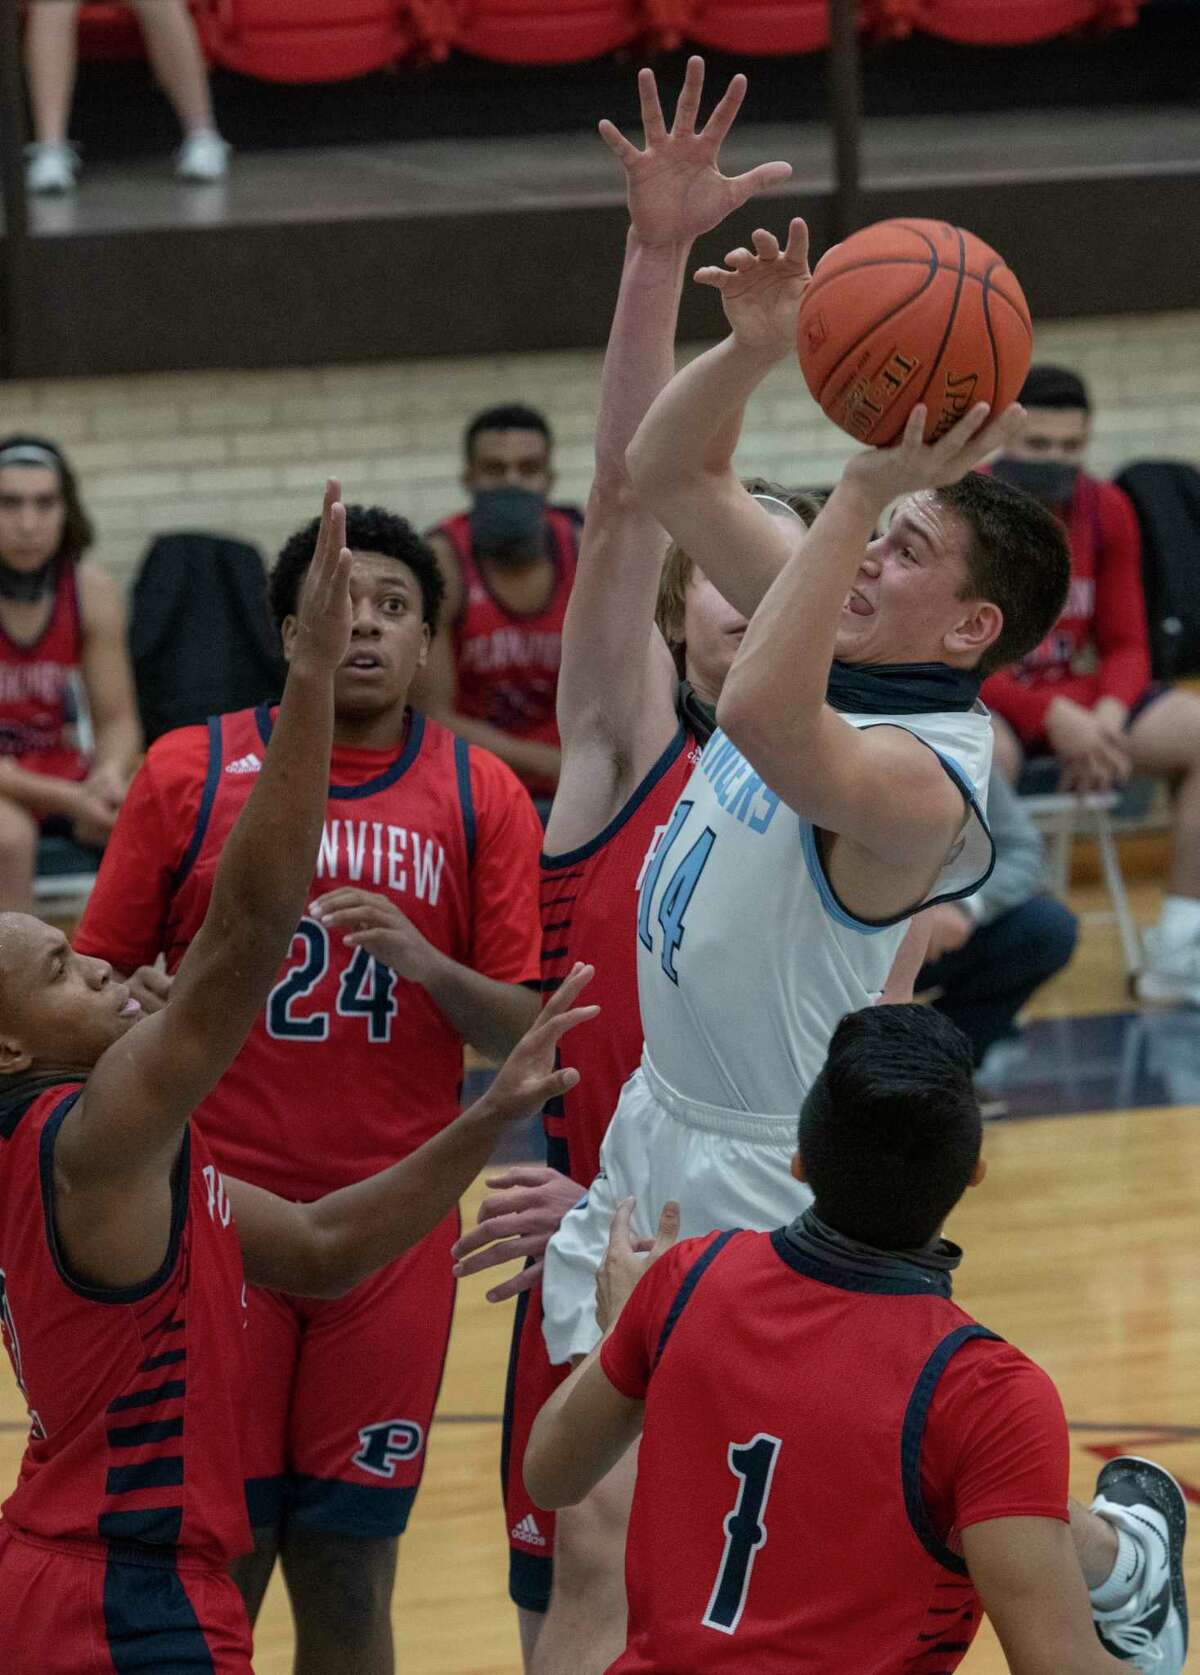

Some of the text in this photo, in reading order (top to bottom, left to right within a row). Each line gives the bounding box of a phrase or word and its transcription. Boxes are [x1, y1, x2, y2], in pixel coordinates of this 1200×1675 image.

[638, 800, 716, 987] 14
[266, 915, 398, 1044] 24
[352, 1419, 423, 1478] P
[701, 1432, 782, 1635] 1
